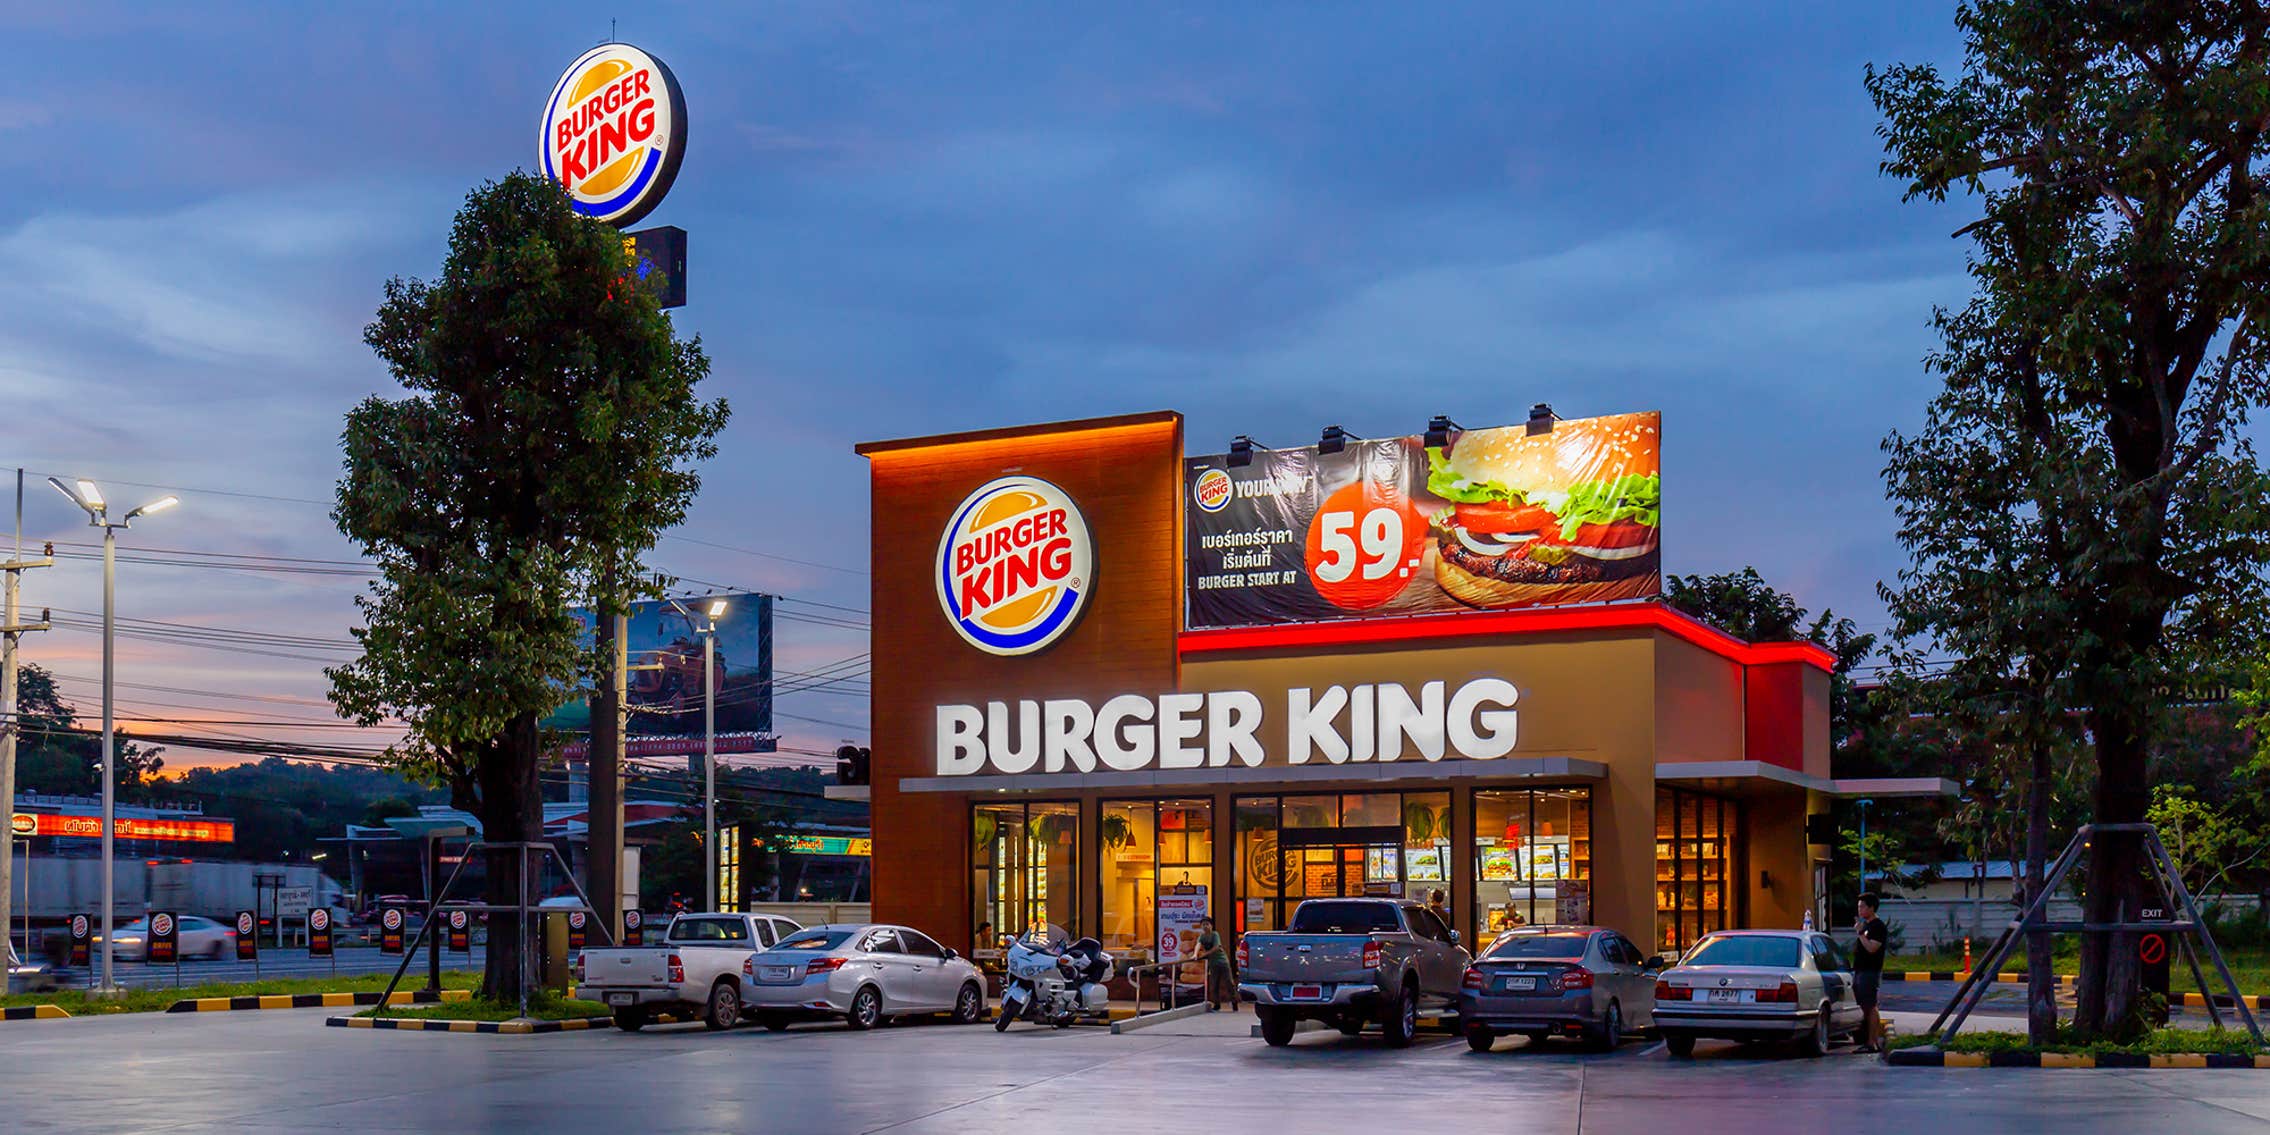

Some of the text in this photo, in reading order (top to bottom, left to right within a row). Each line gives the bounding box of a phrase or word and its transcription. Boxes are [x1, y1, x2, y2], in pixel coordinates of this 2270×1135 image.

[557, 69, 651, 154] BURGER
[561, 98, 655, 190] KING
[1200, 476, 1228, 493] BURGER
[1201, 484, 1229, 502] KING
[957, 508, 1068, 577] BURGER
[1201, 527, 1293, 549] เบอร์เกอร์ราคา
[1223, 545, 1271, 569] เริ่มต้นที่
[961, 537, 1072, 619] KING
[1198, 570, 1297, 590] BURGER START AT
[937, 678, 1520, 776] BURGER KING
[2141, 908, 2163, 918] EXIT
[1163, 936, 1175, 948] 39
